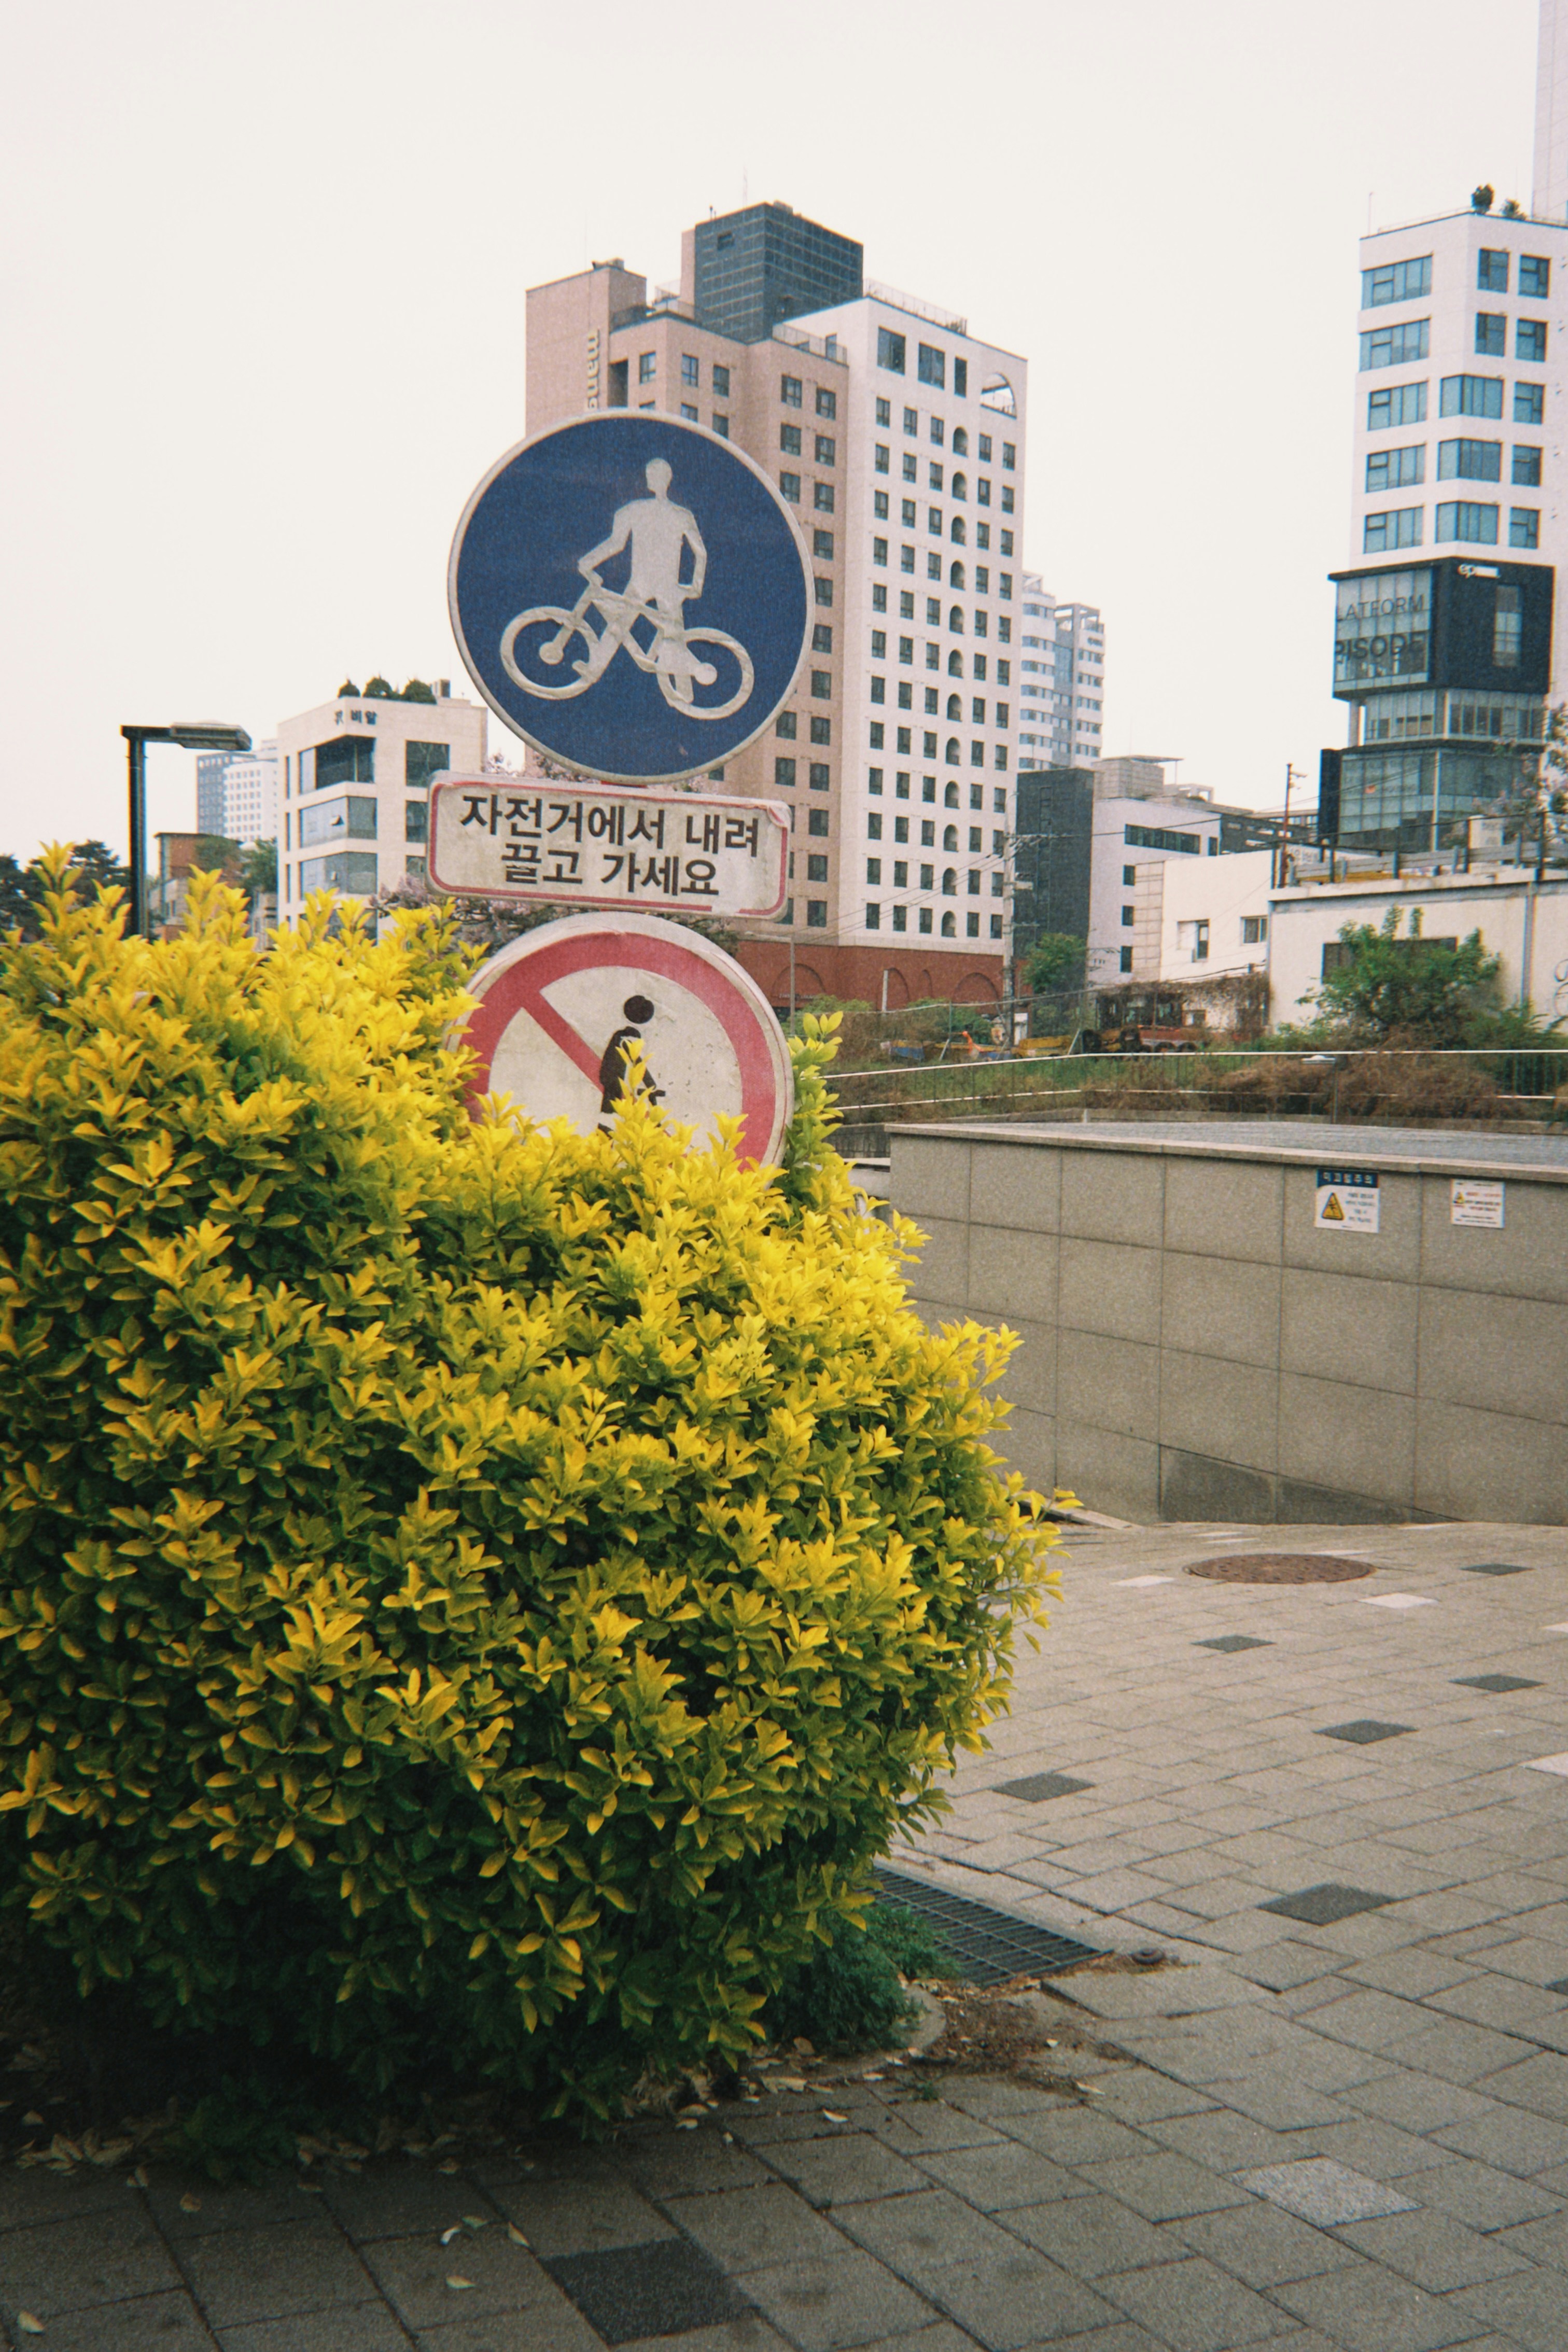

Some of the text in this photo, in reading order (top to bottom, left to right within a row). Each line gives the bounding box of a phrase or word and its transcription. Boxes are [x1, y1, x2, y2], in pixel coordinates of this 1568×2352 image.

[460, 794, 758, 857] 자전거에서 내려
[501, 843, 719, 896] 끌고 가세요
